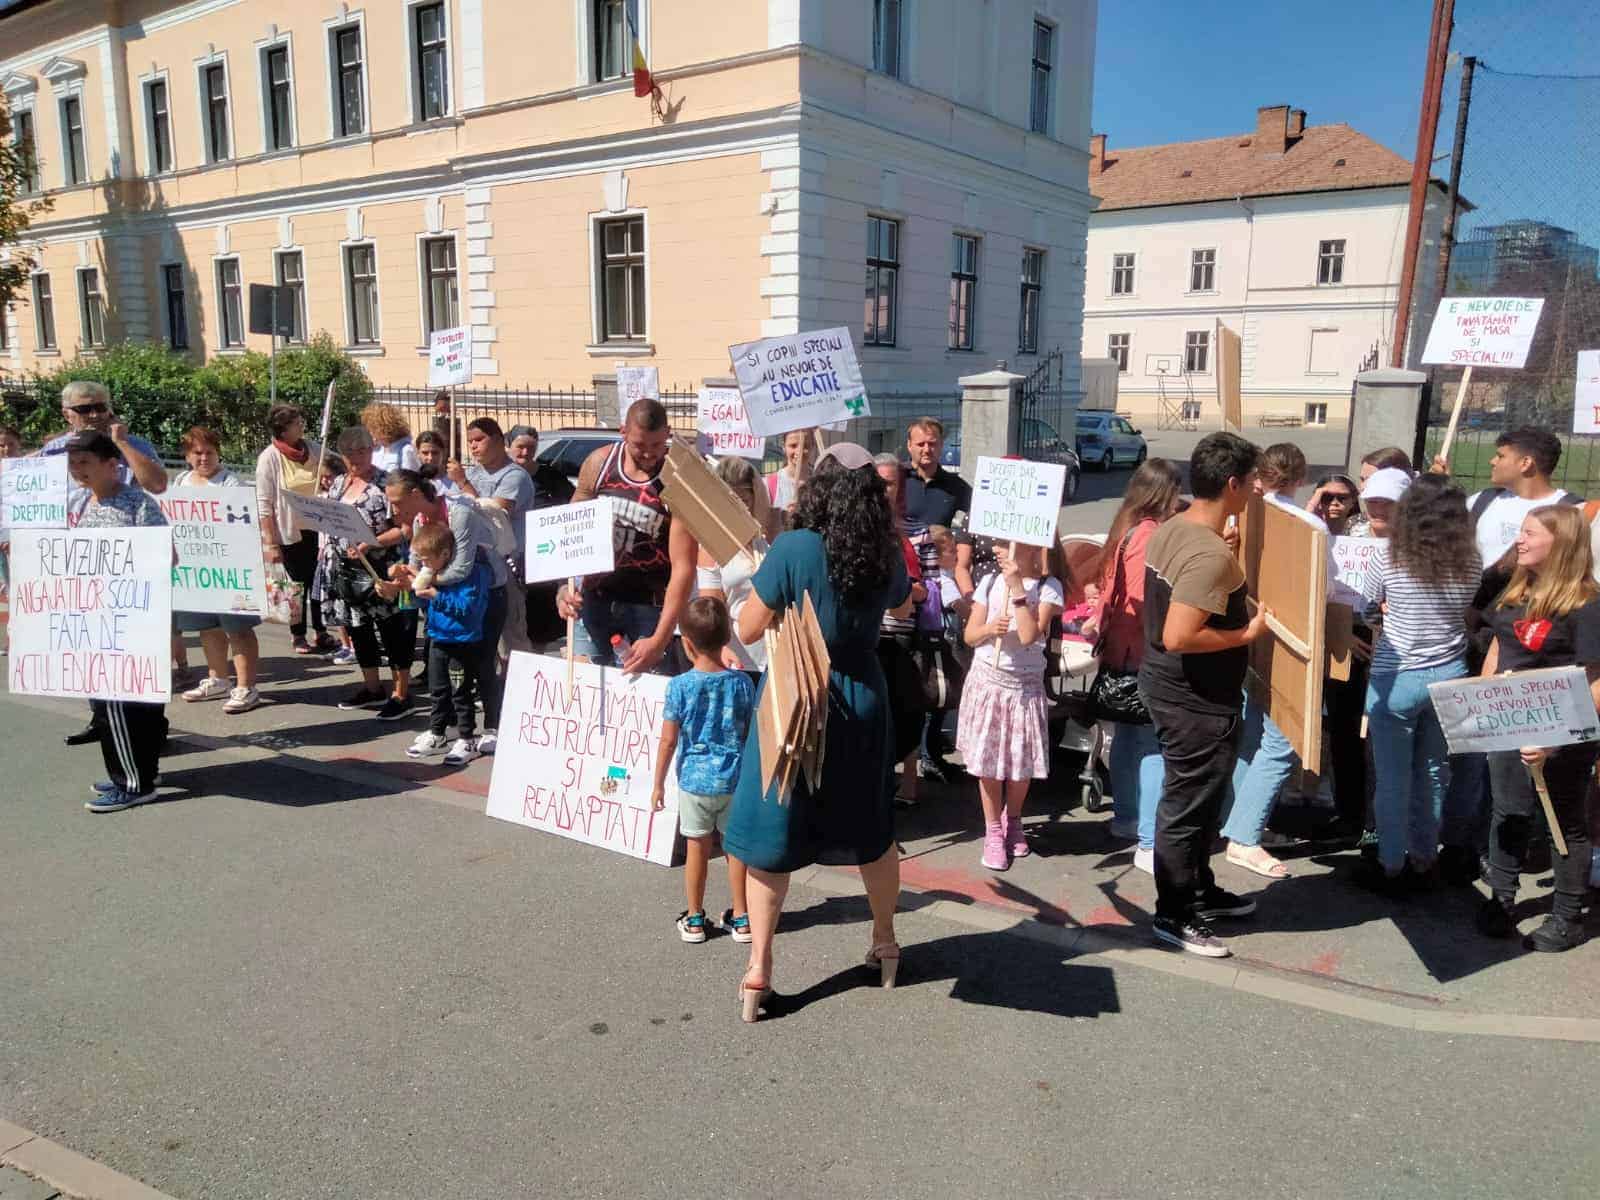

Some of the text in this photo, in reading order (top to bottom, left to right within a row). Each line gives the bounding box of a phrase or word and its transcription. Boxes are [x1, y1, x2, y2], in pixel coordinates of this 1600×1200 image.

[1449, 302, 1458, 313] E
[1462, 327, 1477, 336] DE
[1470, 337, 1481, 347] SI
[746, 351, 760, 368] SI
[803, 335, 842, 355] SPECIALI
[762, 355, 833, 383] AU NEVOIE DE
[770, 371, 841, 404] EDUCATIE
[16, 472, 48, 492] EGALI
[991, 478, 1033, 500] EGALI
[160, 499, 223, 522] NITATE
[39, 537, 135, 576] REVIZUIREA
[1354, 545, 1376, 557] COP
[171, 566, 254, 591] ATIONALE
[99, 614, 129, 651] DE
[13, 653, 57, 692] ACTUL
[1453, 691, 1468, 704] SI
[1520, 678, 1573, 695] SPECIALI
[1467, 693, 1558, 716] AU NEVOIE DE
[1475, 706, 1563, 731] EDUCATIE
[519, 711, 661, 771] RESTRUCTURA
